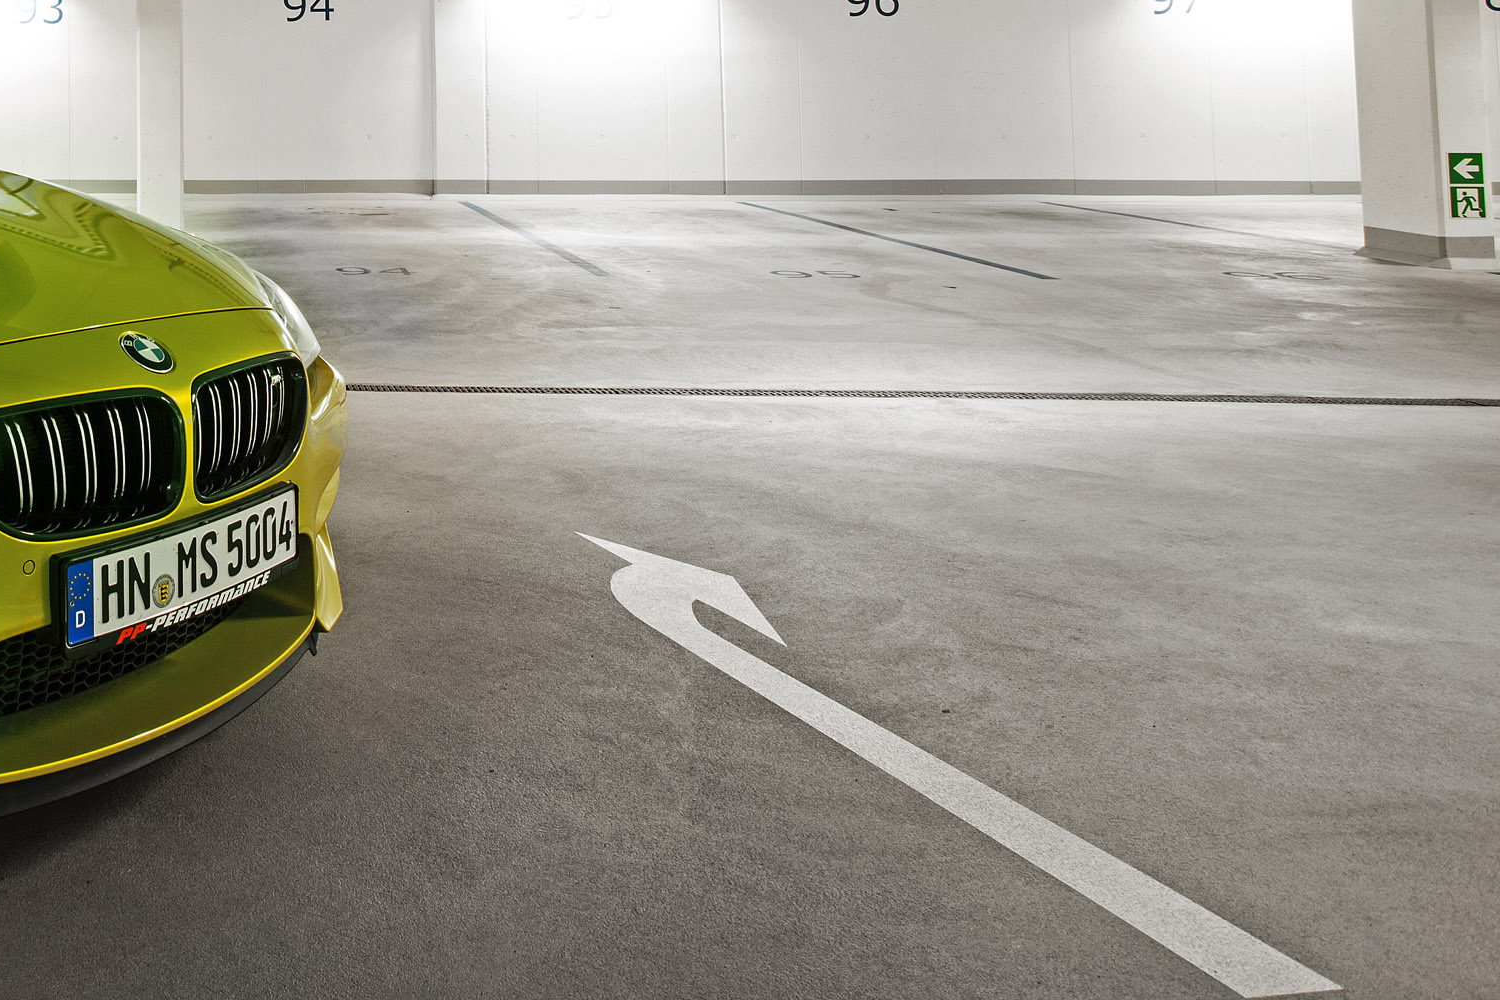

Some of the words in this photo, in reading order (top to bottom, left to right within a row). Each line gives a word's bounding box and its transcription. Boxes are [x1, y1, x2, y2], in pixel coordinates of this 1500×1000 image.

[336, 266, 417, 276] 94
[769, 269, 862, 279] 95
[101, 551, 152, 624] HN
[178, 532, 218, 598] MS
[227, 500, 294, 577] 5004
[75, 610, 86, 629] D
